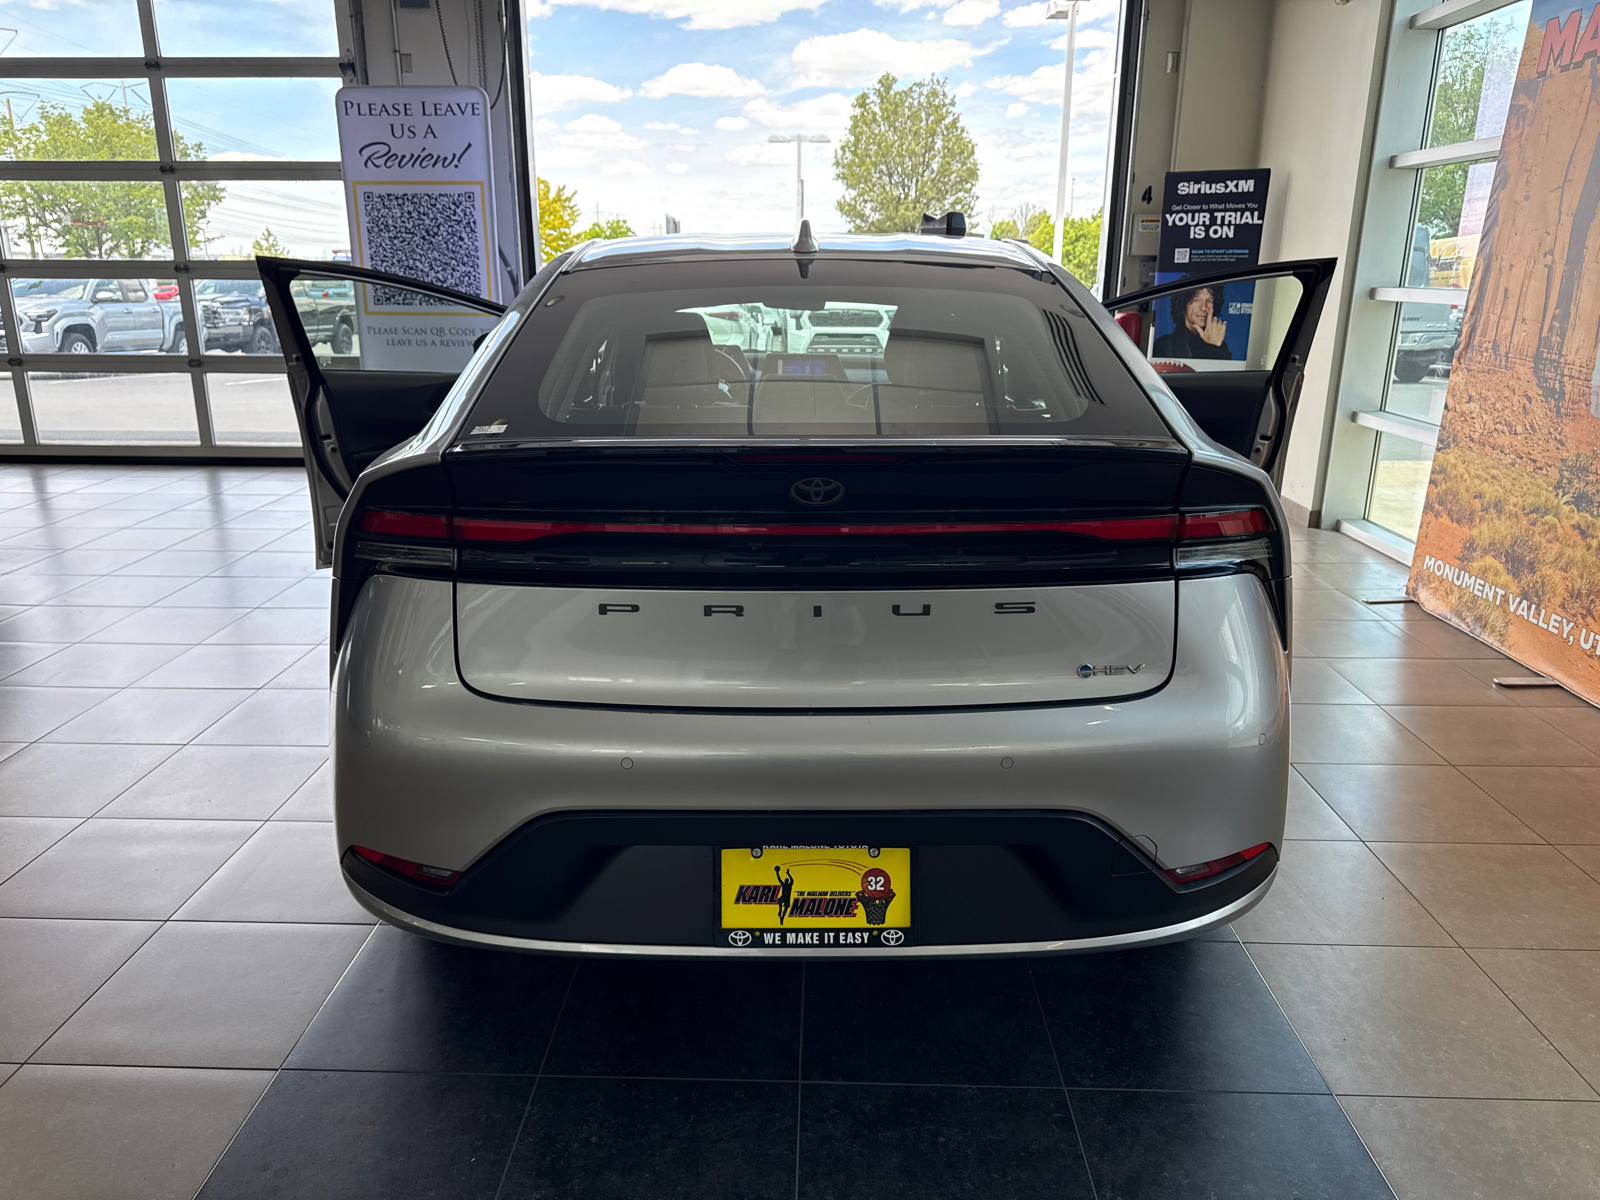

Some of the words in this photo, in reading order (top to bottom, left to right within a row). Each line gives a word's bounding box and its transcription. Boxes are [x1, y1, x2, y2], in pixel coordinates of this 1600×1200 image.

[342, 100, 414, 117] PLEASE
[420, 100, 481, 117] LEAVE
[422, 123, 439, 139] A
[358, 141, 473, 169] Review!
[1177, 179, 1255, 195] SiriusXM
[1141, 185, 1152, 205] 4
[1183, 203, 1201, 211] Closer
[1246, 201, 1258, 209] You
[1165, 212, 1210, 226] YOUR
[1214, 211, 1263, 225] TRIAL
[1189, 226, 1206, 239] IS
[1209, 225, 1234, 238] ON
[367, 326, 399, 335] PLEASE
[402, 326, 428, 336] SCAN
[430, 327, 447, 337] QR
[448, 327, 477, 336] CODE
[386, 338, 413, 347] LEAVE
[415, 338, 428, 347] US
[431, 338, 437, 347] A
[1423, 554, 1505, 606] MONUMENT
[1508, 593, 1575, 646] VALLEY,
[598, 602, 1036, 617] PRIUS
[867, 876, 885, 891] 32
[734, 885, 781, 904] KARL
[788, 897, 859, 917] MALONE
[763, 933, 782, 945] WE
[786, 933, 820, 944] MAKE
[824, 933, 835, 944] IT
[839, 932, 869, 943] EASY
